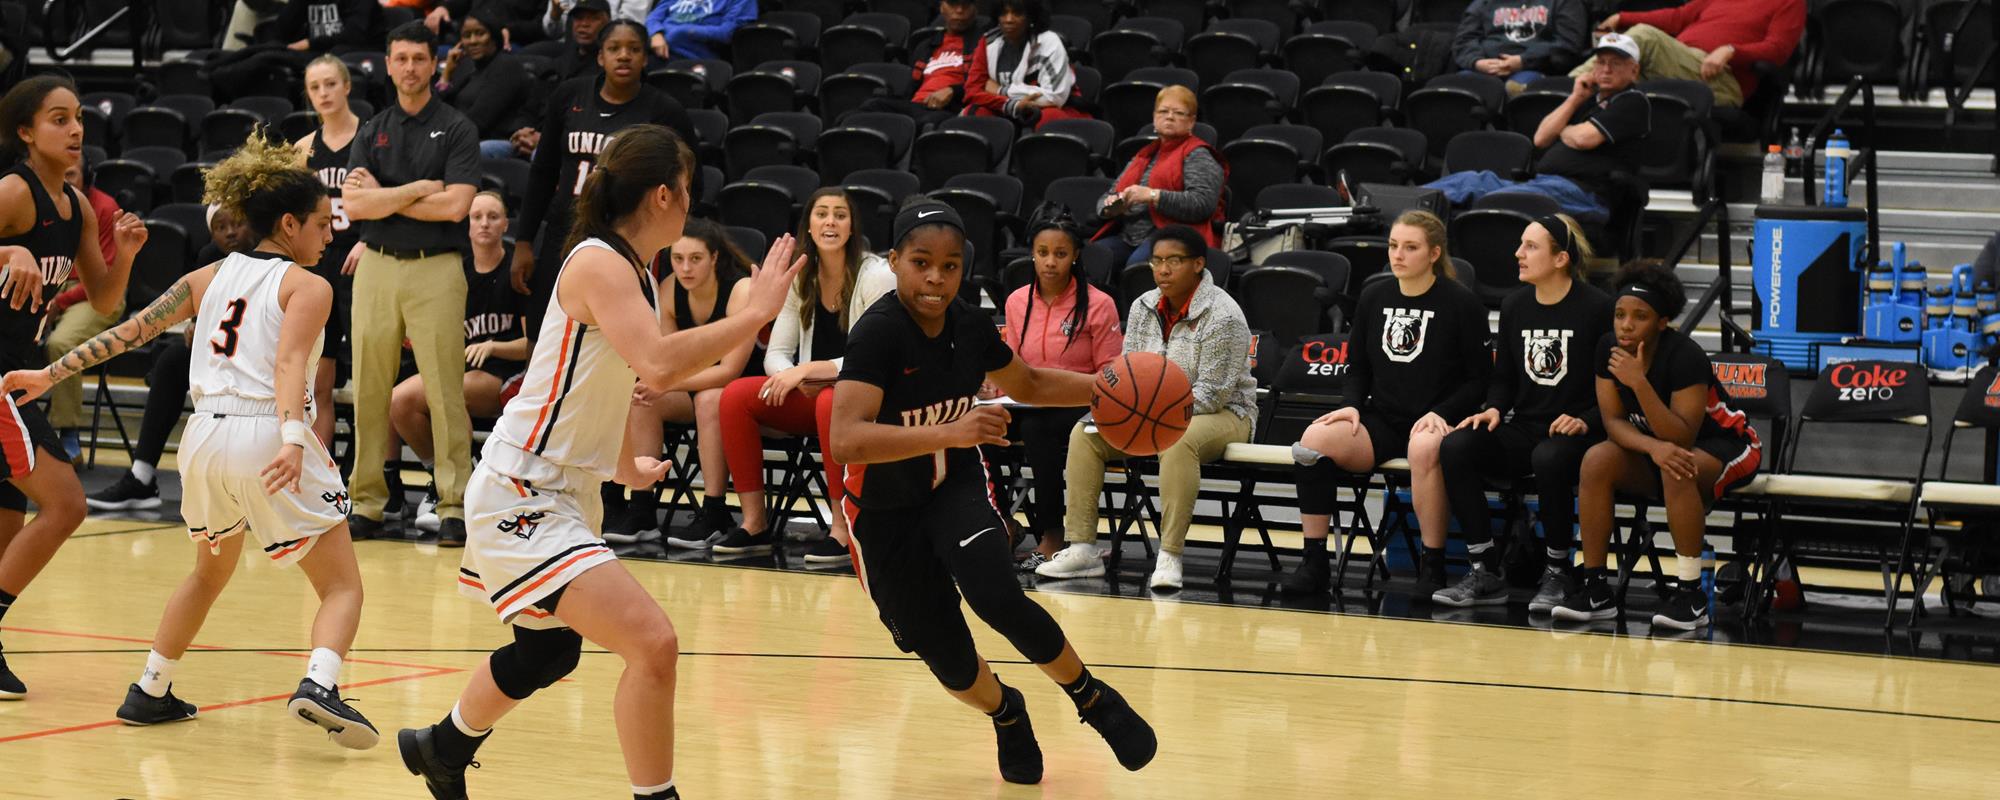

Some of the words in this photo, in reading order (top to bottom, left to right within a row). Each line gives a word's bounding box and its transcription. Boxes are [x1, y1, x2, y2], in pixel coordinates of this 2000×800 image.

[319, 166, 348, 189] NIO
[1770, 226, 1783, 328] POWERADE
[209, 297, 248, 359] 3
[1307, 362, 1350, 376] zer
[1711, 362, 1767, 387] UM
[1831, 364, 1908, 389] Coke
[1838, 387, 1893, 401] zero
[901, 395, 978, 427] UNIO
